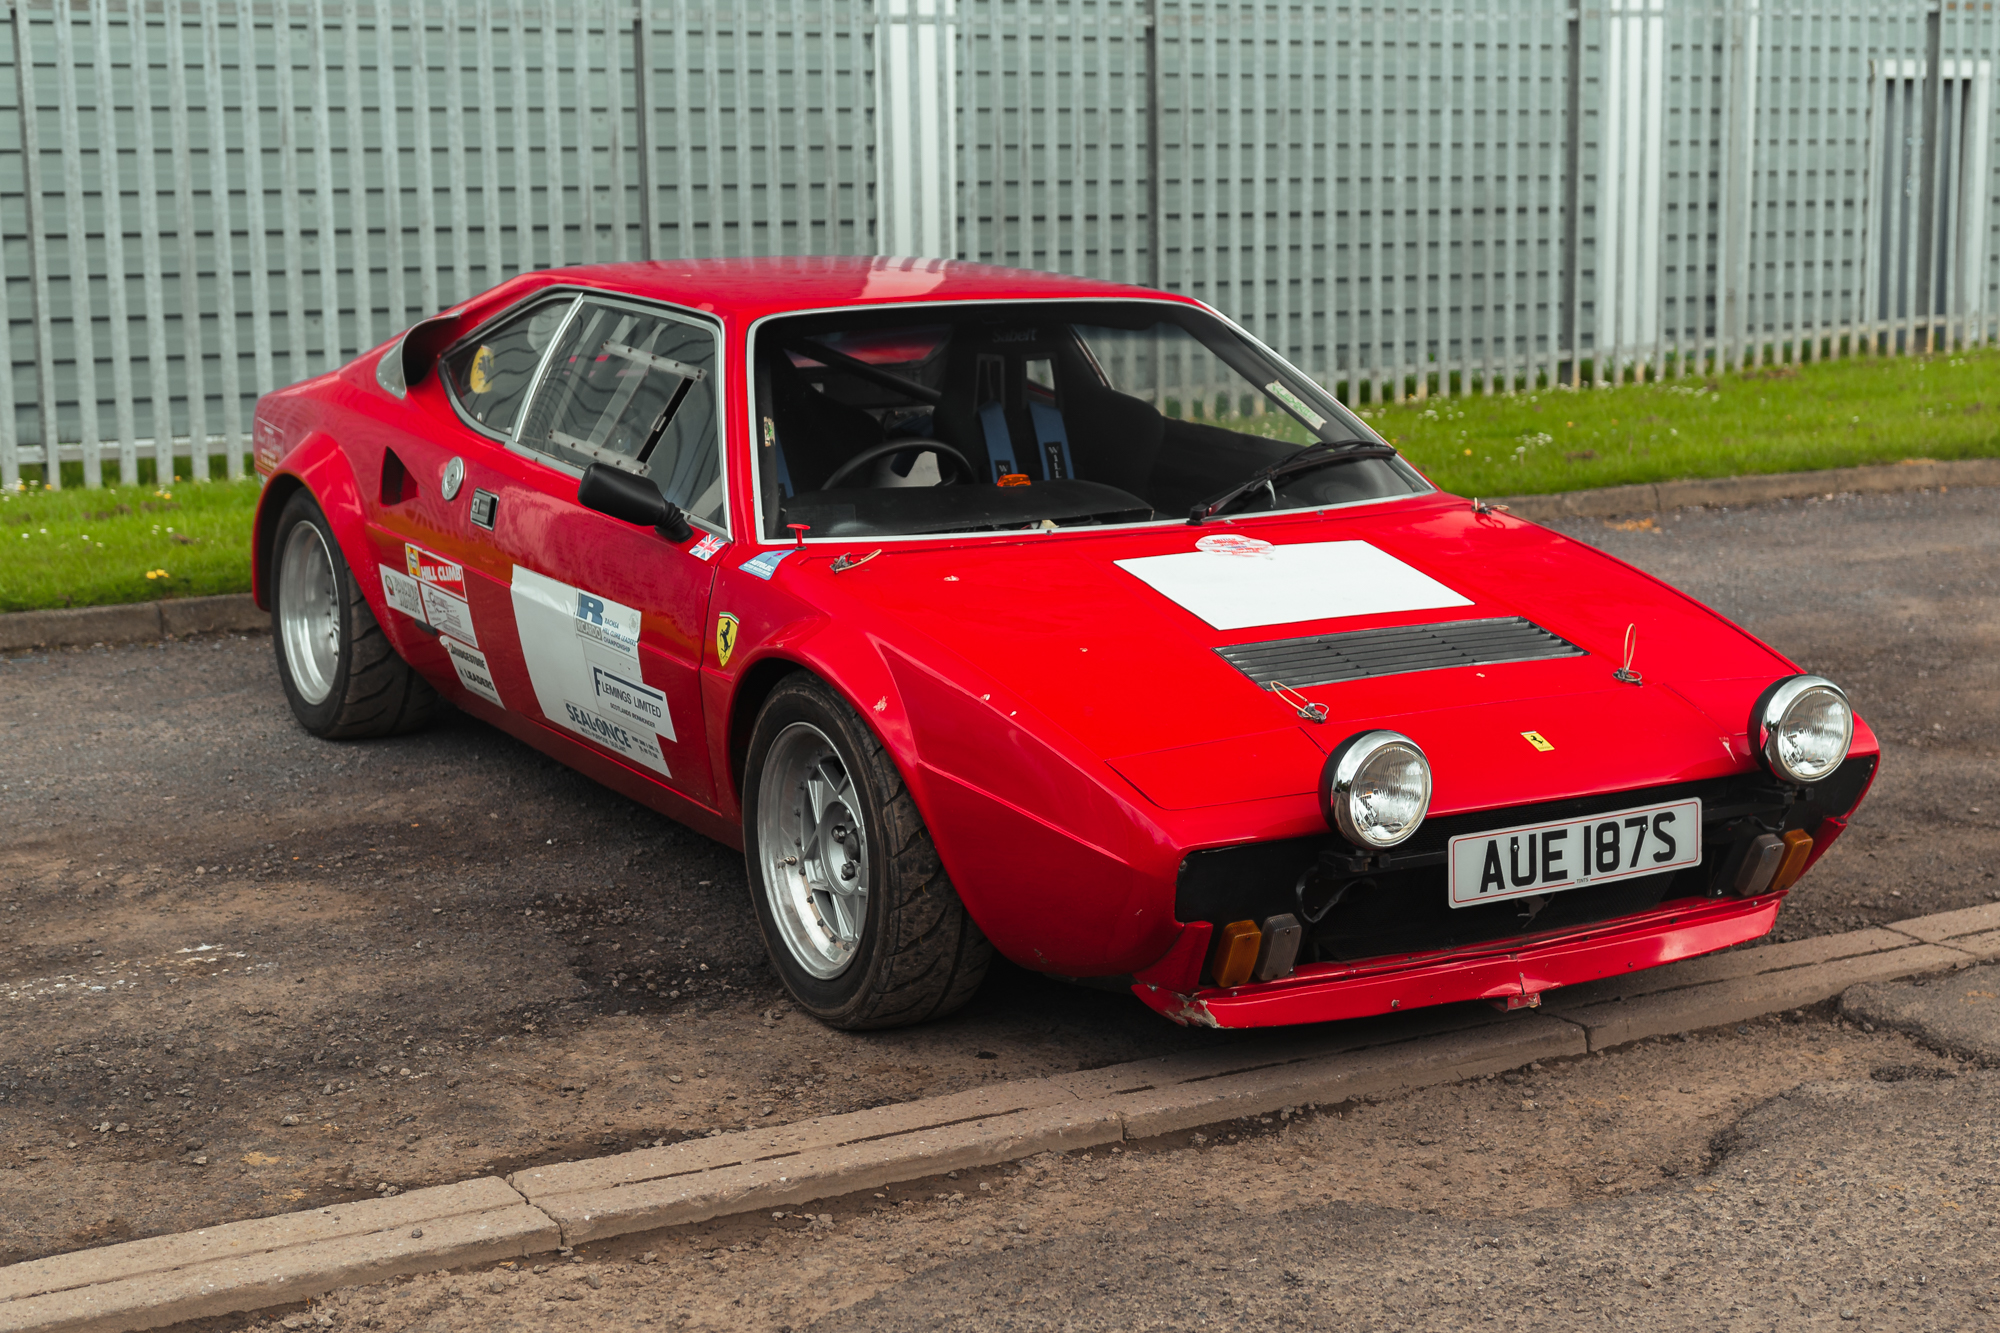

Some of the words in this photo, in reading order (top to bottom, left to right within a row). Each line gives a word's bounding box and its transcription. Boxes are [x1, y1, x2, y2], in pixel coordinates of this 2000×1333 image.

[992, 328, 1038, 343] Sabelt
[420, 565, 438, 581] HILL
[437, 565, 462, 581] CLIMB
[576, 618, 603, 641] RICARDO
[463, 668, 495, 692] LEADERS
[633, 696, 662, 718] LIMITED
[1479, 828, 1568, 893] AUE
[1583, 811, 1676, 876] 187S
